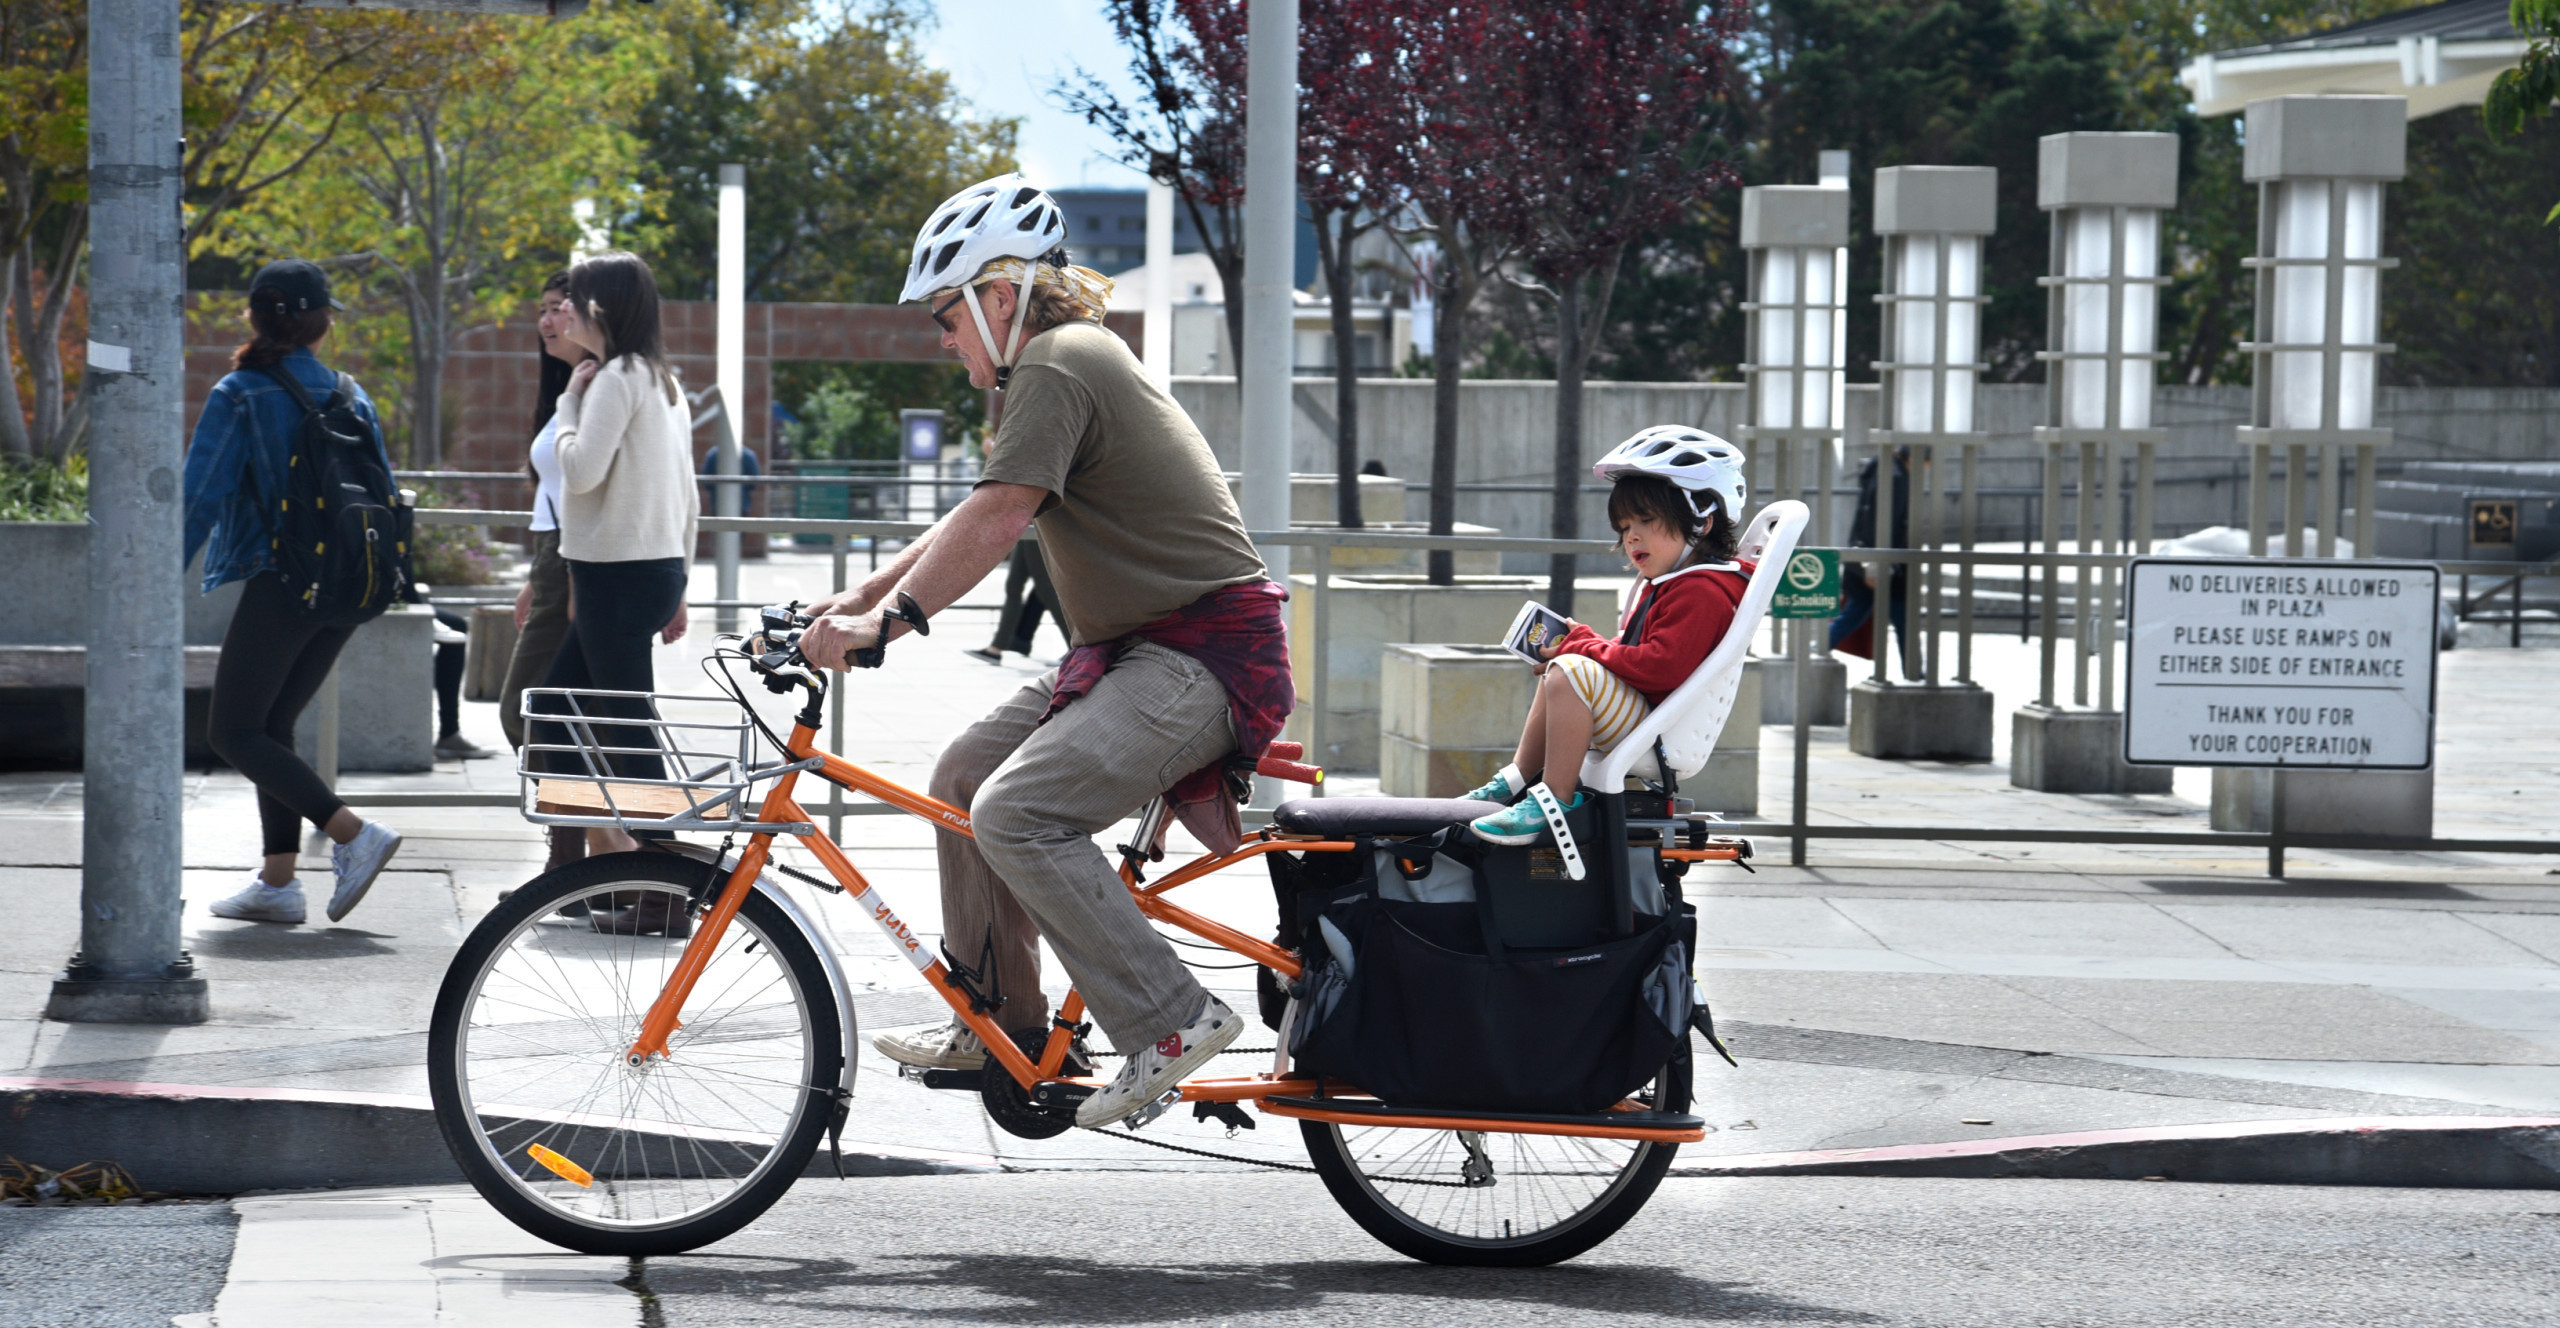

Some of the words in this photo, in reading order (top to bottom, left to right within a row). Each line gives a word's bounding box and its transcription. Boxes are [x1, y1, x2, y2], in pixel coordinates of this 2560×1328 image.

[2168, 574, 2193, 593] NO
[2201, 575, 2308, 595] DELIVERIES
[2313, 577, 2400, 597] ALLOWED
[1791, 593, 1836, 610] Smoking
[2241, 598, 2259, 616] IN
[2266, 599, 2325, 617] PLAZA
[2174, 626, 2245, 645] PLEASE
[2252, 627, 2288, 646] USE
[2296, 628, 2359, 648] RAMPS
[2366, 630, 2392, 648] ON
[2160, 655, 2222, 674] EITHER
[2229, 656, 2271, 675] SIDE
[2279, 657, 2302, 675] OF
[2309, 658, 2405, 678] ENTRANCE
[2208, 704, 2267, 724] THANK
[2274, 706, 2311, 725] YOU
[2318, 707, 2354, 726] FOR
[2189, 734, 2238, 752] YOUR
[2245, 735, 2372, 755] COOPERATION
[875, 901, 921, 953] yuba
